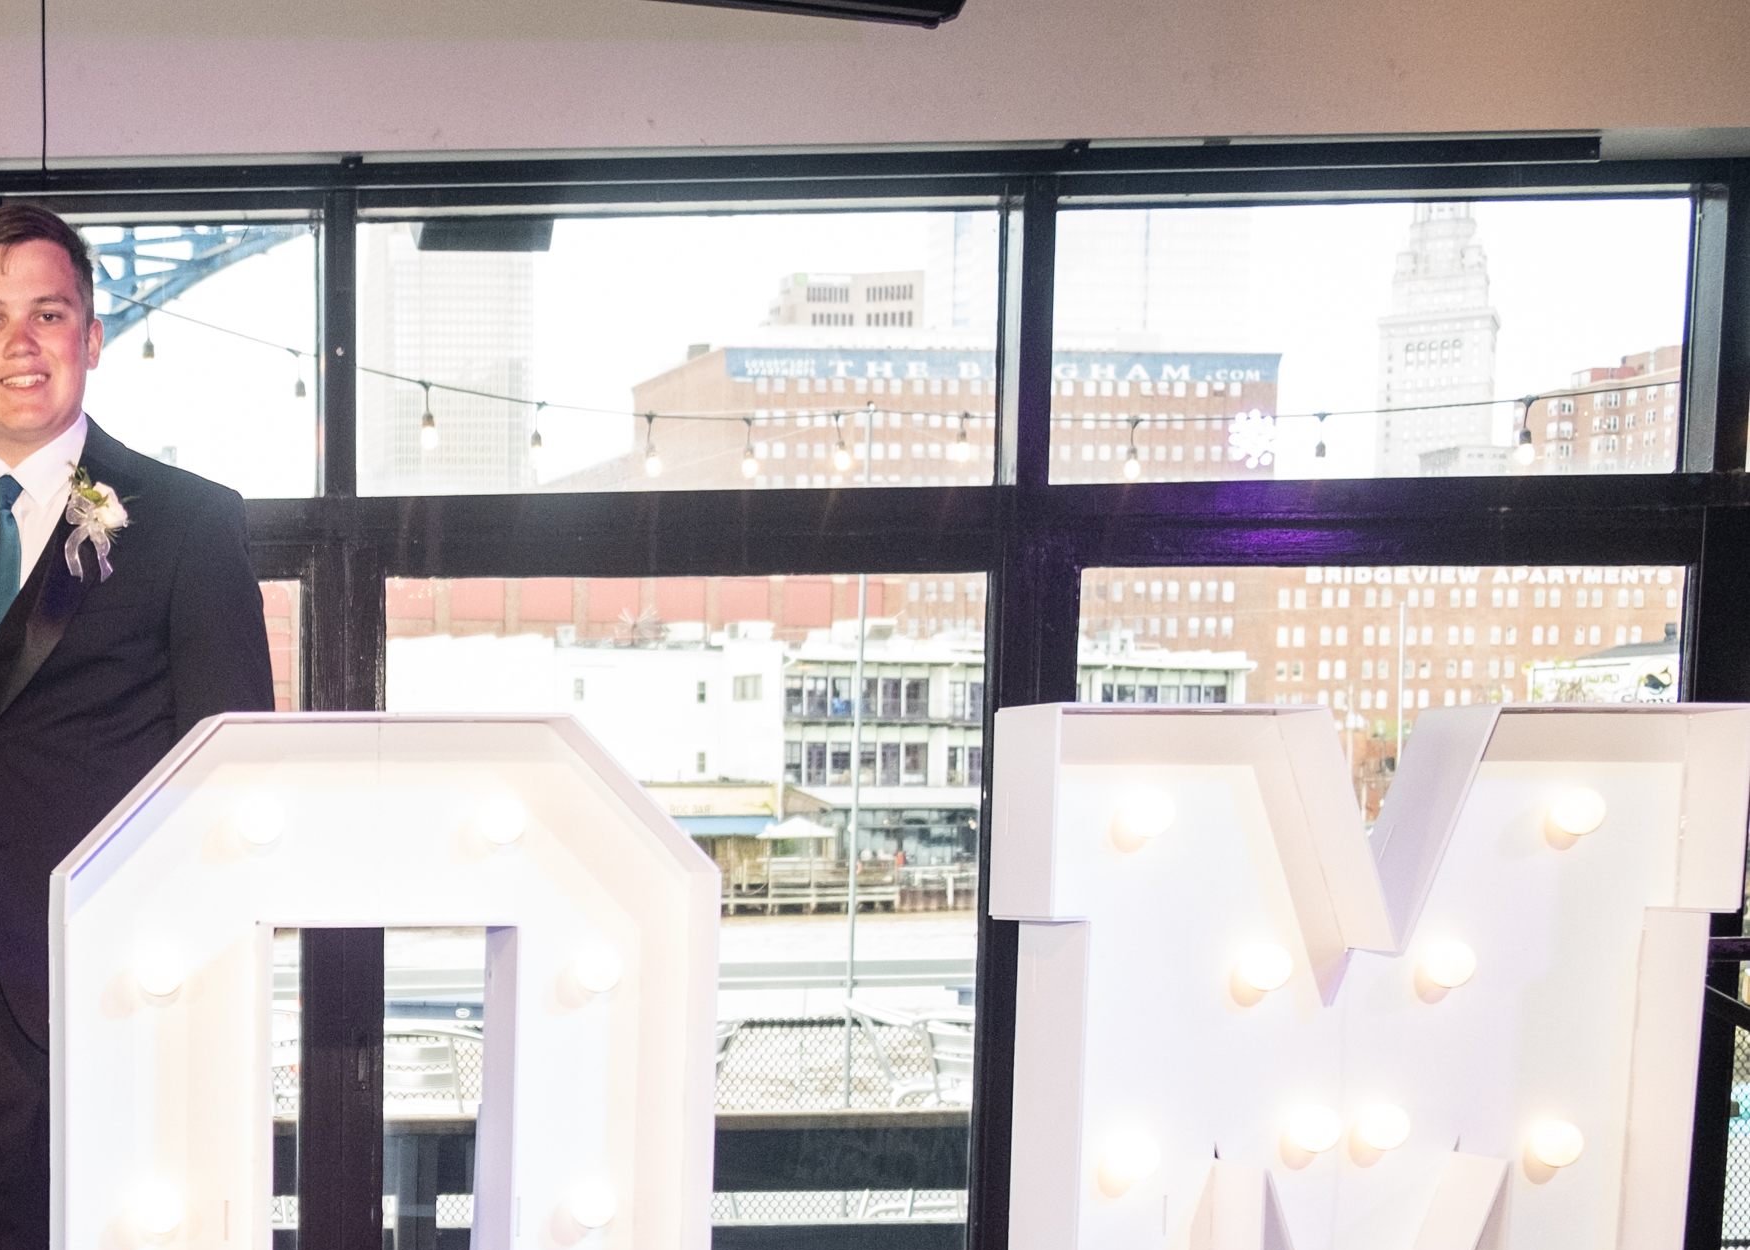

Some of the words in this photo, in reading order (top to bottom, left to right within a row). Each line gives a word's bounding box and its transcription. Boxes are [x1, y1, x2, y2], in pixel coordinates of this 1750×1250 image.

[828, 360, 929, 378] THE
[959, 361, 1191, 381] BGHAM
[1305, 567, 1480, 584] BRIDGEVIEW
[1492, 567, 1673, 584] APARTMENTS
